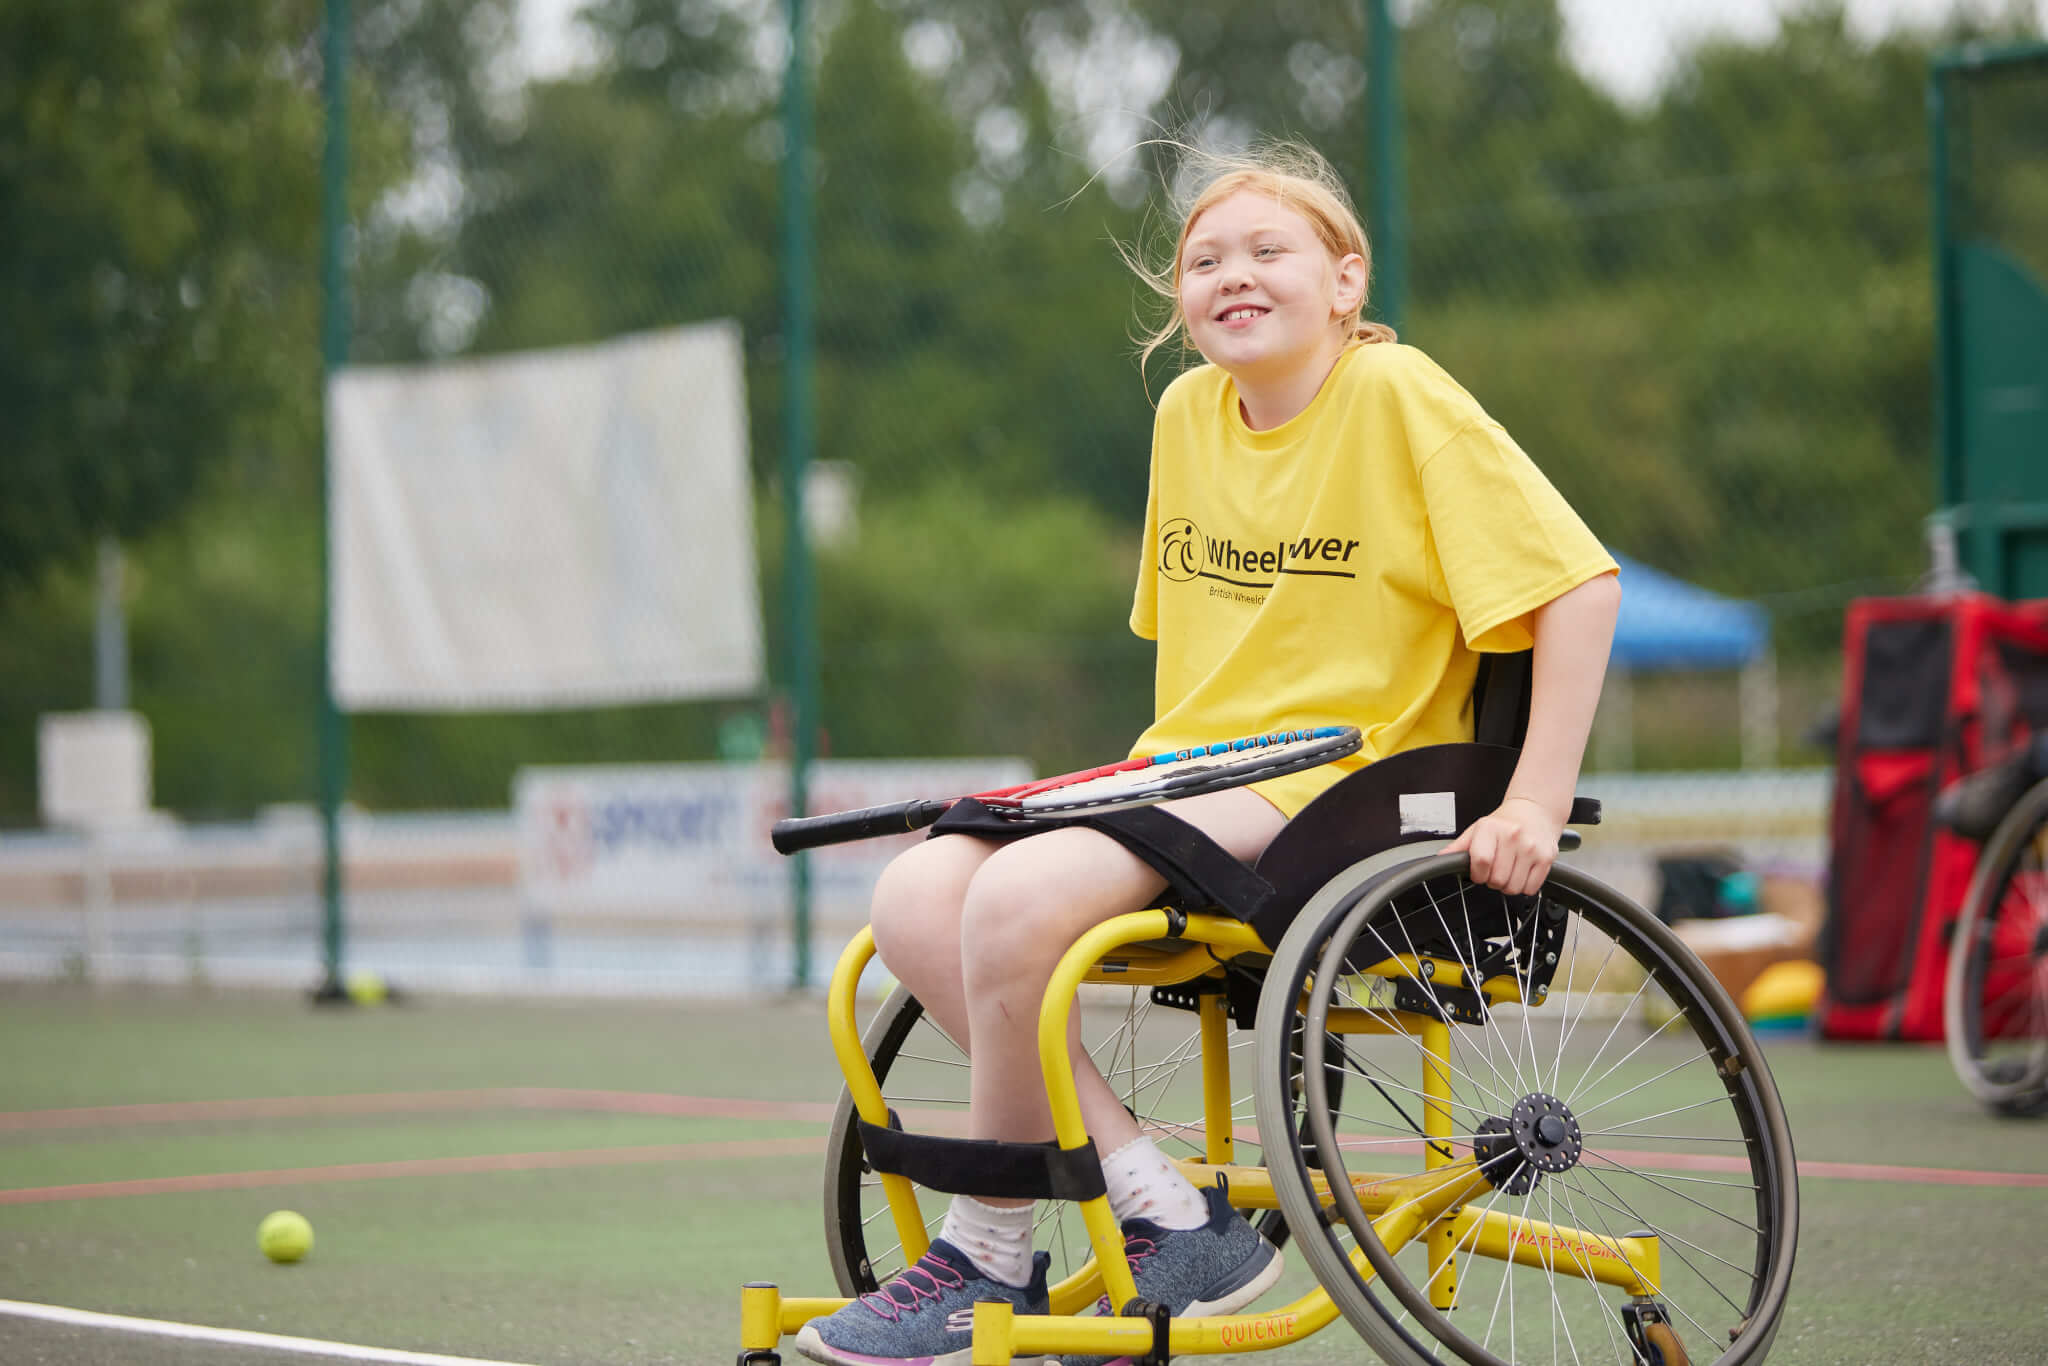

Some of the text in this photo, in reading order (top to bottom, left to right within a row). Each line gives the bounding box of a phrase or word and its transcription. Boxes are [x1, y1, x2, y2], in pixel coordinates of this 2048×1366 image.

[1209, 586, 1233, 601] British
[1511, 1230, 1571, 1251] MATCH
[1222, 1317, 1294, 1347] QUICKIE
